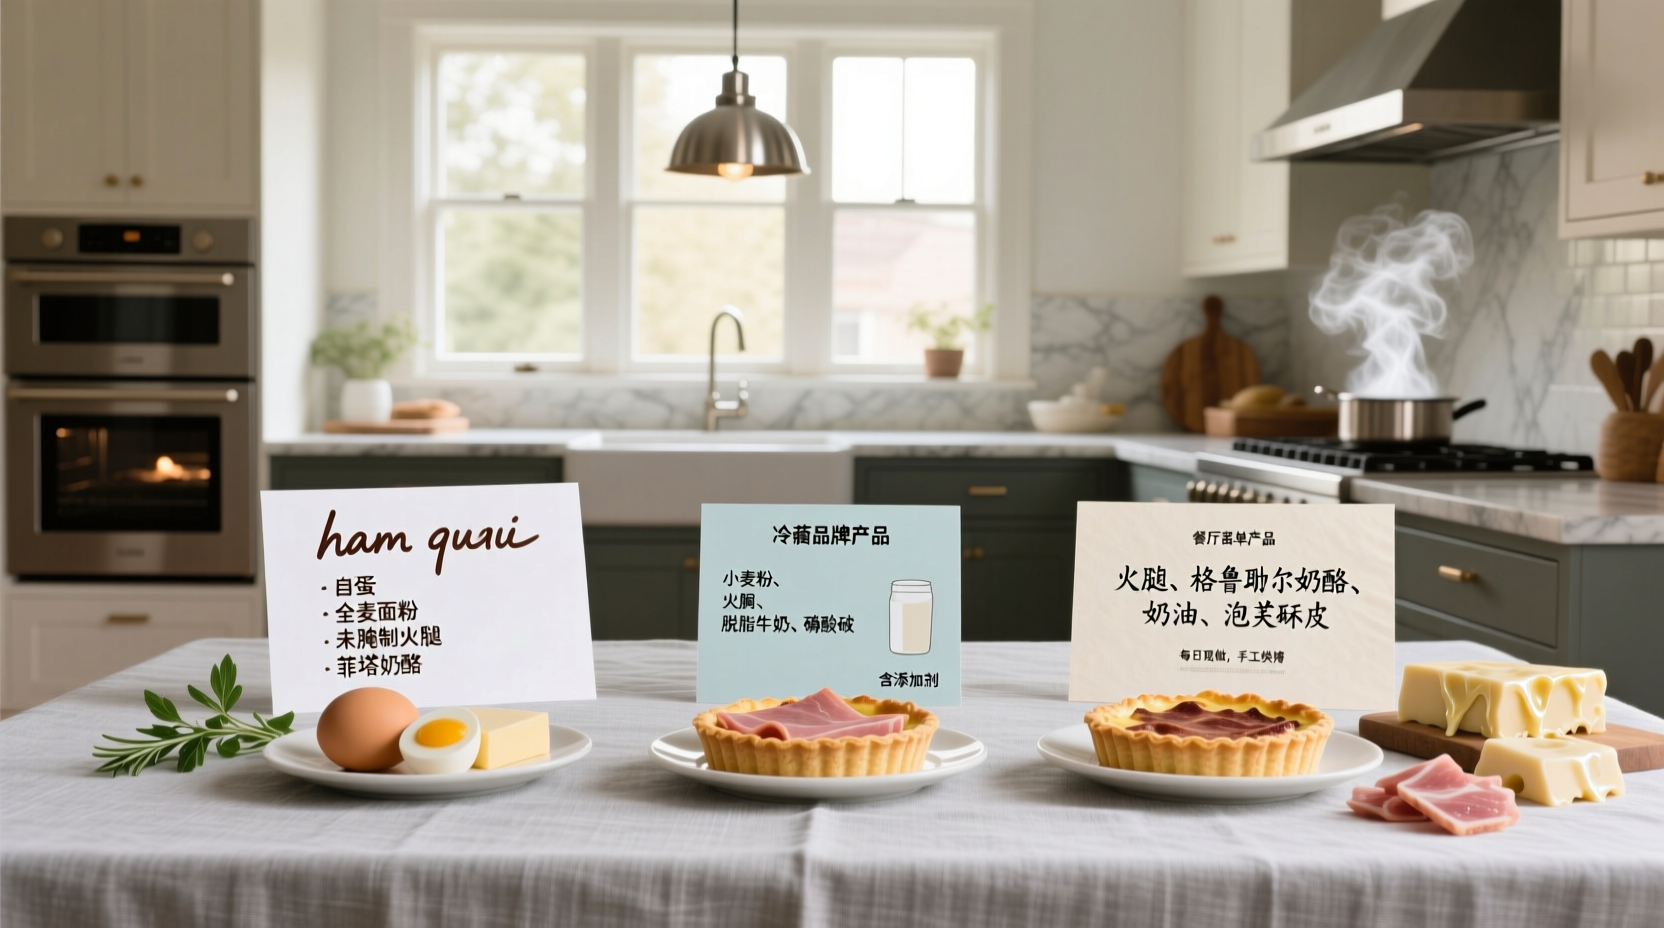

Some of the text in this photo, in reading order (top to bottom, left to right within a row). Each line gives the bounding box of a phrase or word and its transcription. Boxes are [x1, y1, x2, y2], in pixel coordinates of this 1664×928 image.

[317, 510, 412, 560] ham
[723, 569, 780, 588] 小麦粉、
[335, 600, 418, 624] 全麦面粉
[337, 653, 423, 679] 菲塔奶酪
